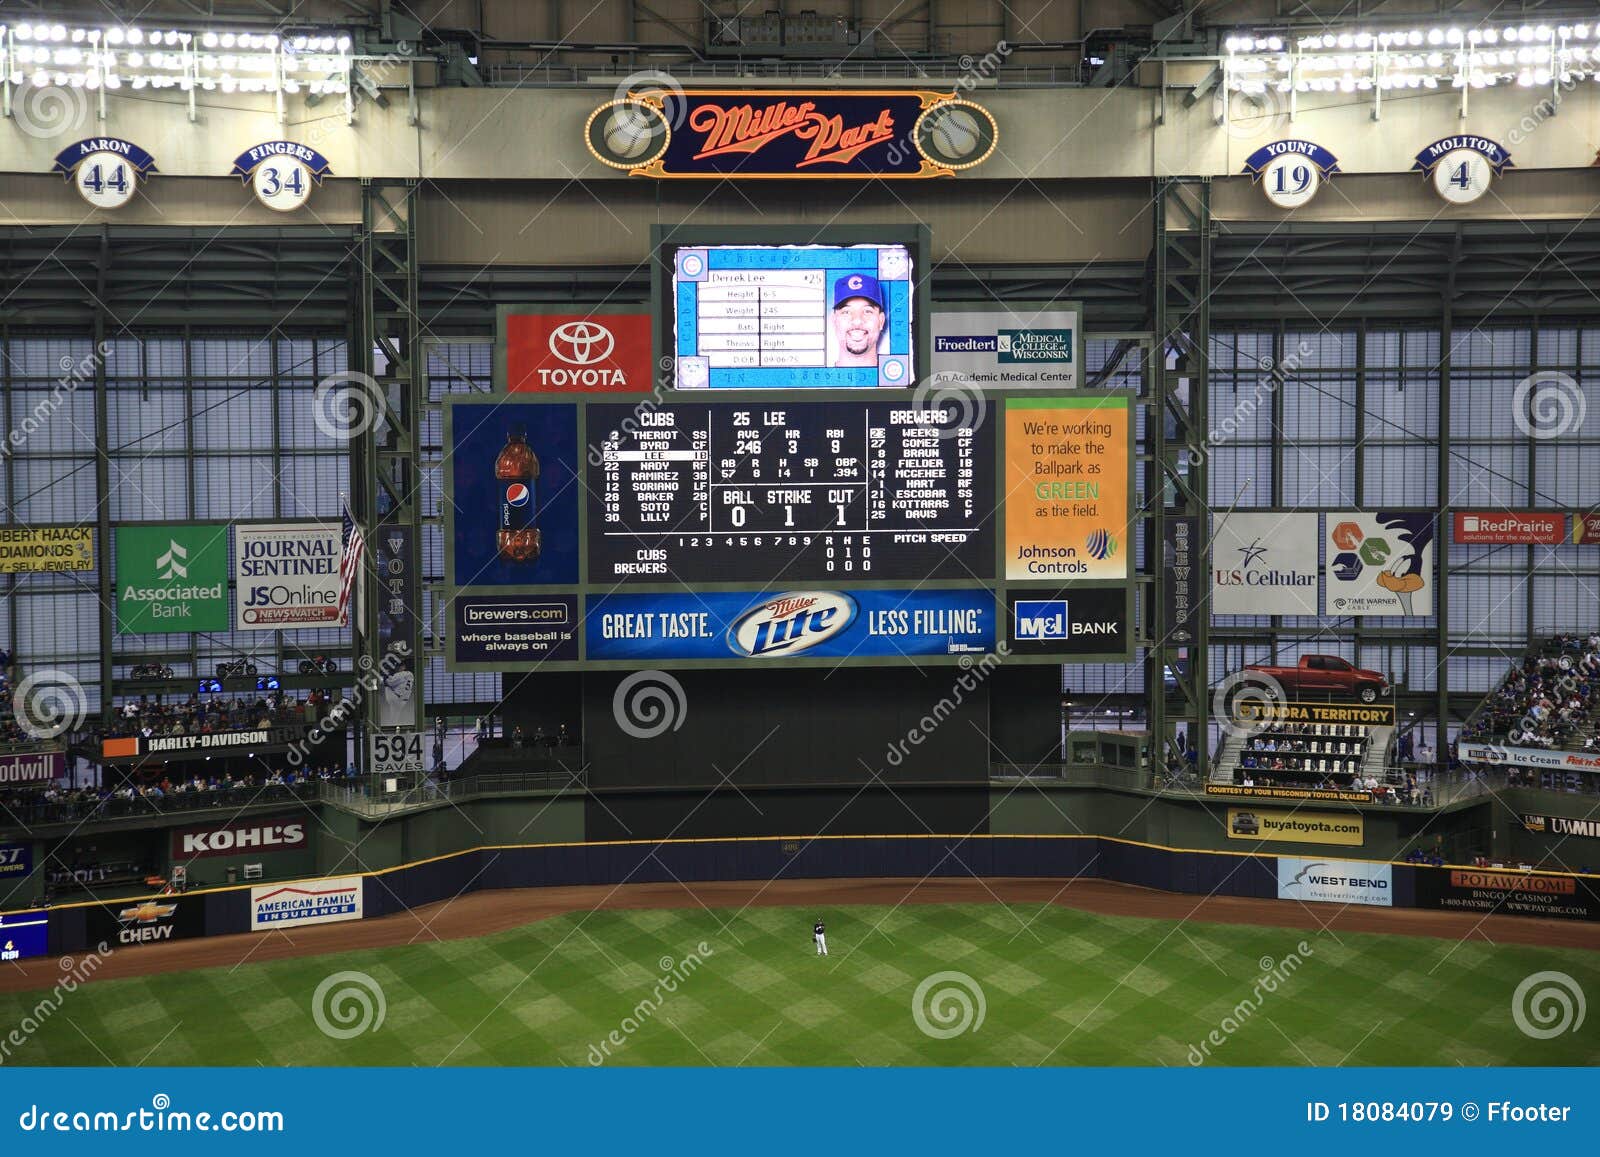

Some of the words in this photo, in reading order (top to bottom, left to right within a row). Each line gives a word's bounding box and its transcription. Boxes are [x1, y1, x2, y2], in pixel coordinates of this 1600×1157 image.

[689, 101, 816, 160] Miller
[795, 108, 895, 169] Park
[80, 139, 131, 155] AARON
[250, 142, 314, 161] FINGERS
[1267, 142, 1318, 156] YOUNT
[1429, 137, 1498, 157] MOLITOR
[83, 164, 129, 194] 44
[261, 167, 304, 198] 34
[1272, 165, 1312, 194] 19
[1450, 161, 1471, 191] 4
[748, 274, 765, 282] Lee
[848, 276, 862, 290] C
[938, 338, 996, 350] Froedtert
[1000, 339, 1009, 349] &
[1020, 333, 1065, 342] MEDICAL
[1012, 341, 1058, 351] COLLEGE
[1012, 350, 1068, 359] WISCONSIN
[538, 369, 627, 386] TOYOTA
[935, 374, 948, 382] An
[952, 373, 998, 382] Academic
[1001, 373, 1037, 382] Medical
[1041, 373, 1072, 382] Center
[641, 413, 675, 427] CUBS
[733, 412, 750, 426] 25
[764, 412, 786, 426] LEE
[890, 410, 947, 424] BREWERS
[632, 431, 678, 440] THERIOT
[738, 430, 759, 439] AVG
[786, 430, 800, 438] HR
[826, 430, 844, 438] RBI
[902, 429, 939, 437] WEEKS
[1024, 422, 1059, 436] We're
[1062, 422, 1112, 438] working
[640, 441, 669, 450] BYRD
[734, 440, 761, 454] .246
[902, 439, 939, 447] GOMEZ
[1031, 444, 1043, 455] to
[1048, 442, 1081, 455] make
[1085, 442, 1104, 455] the
[904, 449, 939, 457] BRAUN
[640, 462, 669, 471] NADY
[899, 460, 943, 468] FIELDER
[1035, 461, 1083, 476] Ballpark
[1087, 464, 1100, 474] as
[631, 472, 679, 481] RAMIREZ
[896, 470, 947, 478] MCGEHEE
[633, 482, 679, 491] SORIANO
[907, 480, 935, 488] HART
[1035, 481, 1099, 500] GREEN
[638, 493, 674, 501] BAKER
[724, 490, 754, 504] BALL
[768, 490, 811, 504] STRIKE
[896, 490, 947, 498] ESCOBAR
[641, 503, 670, 511] SOTO
[892, 500, 949, 508] KOTTARAS
[641, 513, 670, 522] LILLY
[732, 506, 745, 527] 0
[784, 506, 794, 526] 1
[906, 510, 937, 519] DAVIS
[1035, 507, 1048, 517] as
[1052, 506, 1069, 517] the
[1073, 505, 1099, 517] field.
[1480, 519, 1553, 532] RedPrairie
[42, 528, 90, 541] HAACK
[894, 534, 926, 543] PITCH
[931, 534, 967, 543] SPEED
[0, 545, 73, 558] DIAMONDS
[241, 540, 337, 560] JOURNAL
[637, 550, 667, 560] CUBS
[1018, 545, 1076, 559] Johnson
[41, 560, 92, 571] JEWELRY
[241, 558, 338, 576] SENTINEL
[614, 563, 667, 574] BREWERS
[1028, 561, 1087, 574] Controls
[388, 538, 404, 614] VOTE
[1175, 522, 1190, 624] BREWERS
[1216, 570, 1244, 586] U.S.
[1246, 570, 1315, 586] Cellular
[122, 583, 222, 601] Associated
[244, 584, 337, 606] JSOnline
[152, 602, 191, 618] Bank
[260, 608, 325, 618] NEWSWATCH
[766, 597, 818, 617] Miller
[469, 607, 563, 621] brewers.com
[603, 613, 653, 640] GREAT
[661, 612, 713, 639] TASTE.
[869, 610, 909, 636] LESS
[914, 609, 982, 634] FILLING.
[1072, 622, 1118, 634] BANK
[461, 632, 501, 642] where
[505, 631, 557, 641] baseball
[561, 631, 571, 641] is
[750, 606, 837, 656] Lite
[485, 642, 529, 652] always
[532, 641, 548, 650] on
[1253, 706, 1310, 720] TUNDRA
[1312, 708, 1389, 722] TERRITORY
[148, 731, 268, 752] HARLEY-DAVIDSON
[374, 734, 423, 762] 594
[1530, 755, 1561, 765] Cream
[375, 762, 423, 772] SAVES
[1208, 786, 1242, 794] COURTESY
[1254, 788, 1271, 796] YOUR
[1273, 789, 1311, 798] WISCONSIN
[1313, 791, 1338, 799] TOYOTA
[1339, 793, 1369, 801] DEALERS
[1263, 818, 1360, 834] buyatoyota.com
[184, 824, 304, 853] KOHL'S
[1309, 876, 1347, 886] WEST
[1349, 878, 1388, 888] BEND
[1473, 890, 1505, 899] BINGO
[1515, 893, 1552, 903] CASINO
[257, 898, 313, 913] AMERICAN
[317, 894, 355, 906] FAMILY
[264, 905, 349, 921] INSURANCE
[119, 925, 173, 943] CHEVY
[2, 950, 19, 960] RBI
